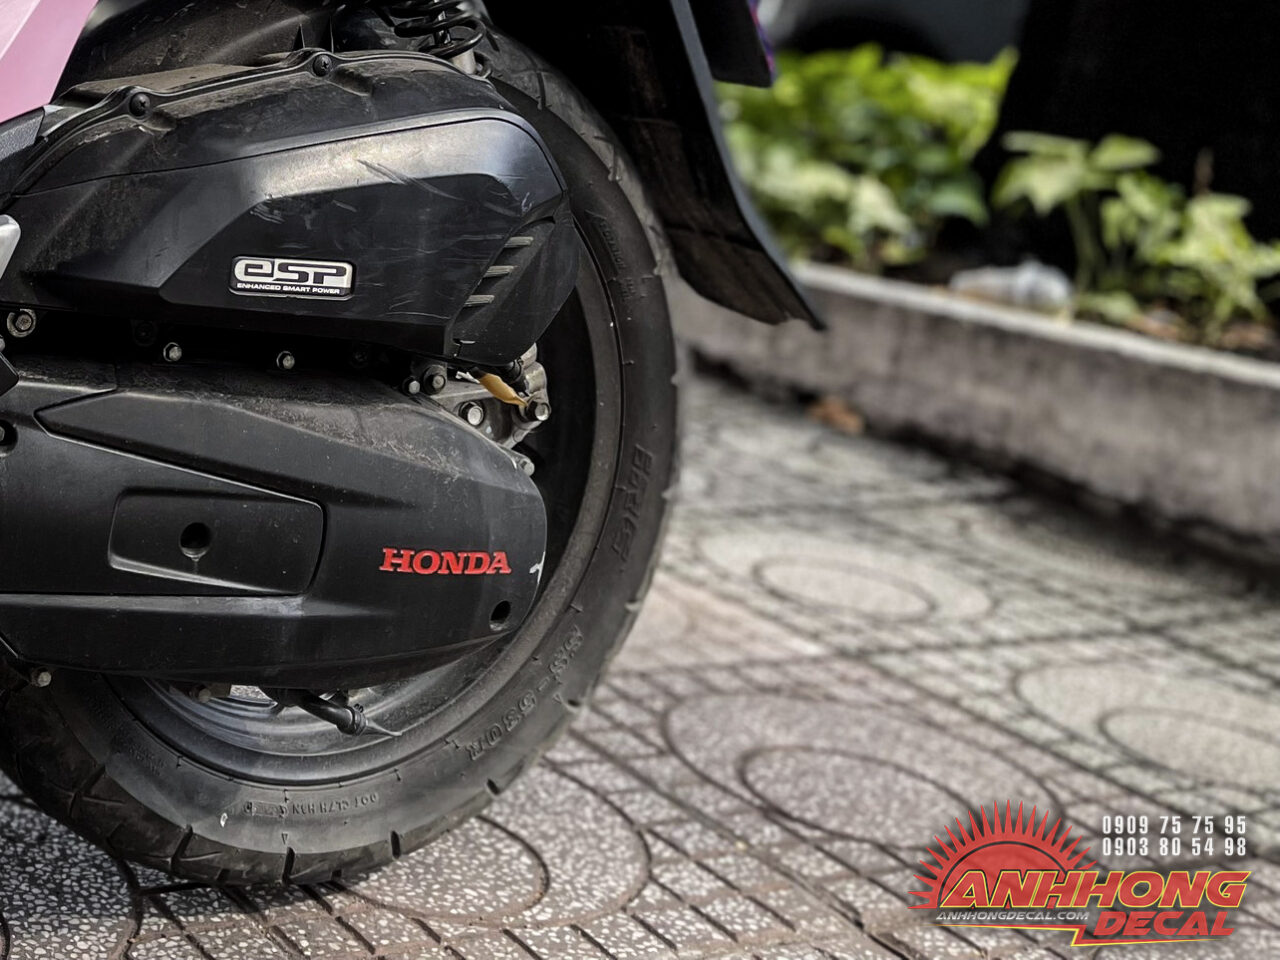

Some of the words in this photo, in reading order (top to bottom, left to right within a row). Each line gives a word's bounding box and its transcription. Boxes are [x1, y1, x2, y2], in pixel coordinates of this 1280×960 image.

[236, 282, 281, 291] ENHANCED
[282, 285, 310, 293] SMART
[312, 287, 340, 295] POWER
[379, 547, 512, 575] HONDA
